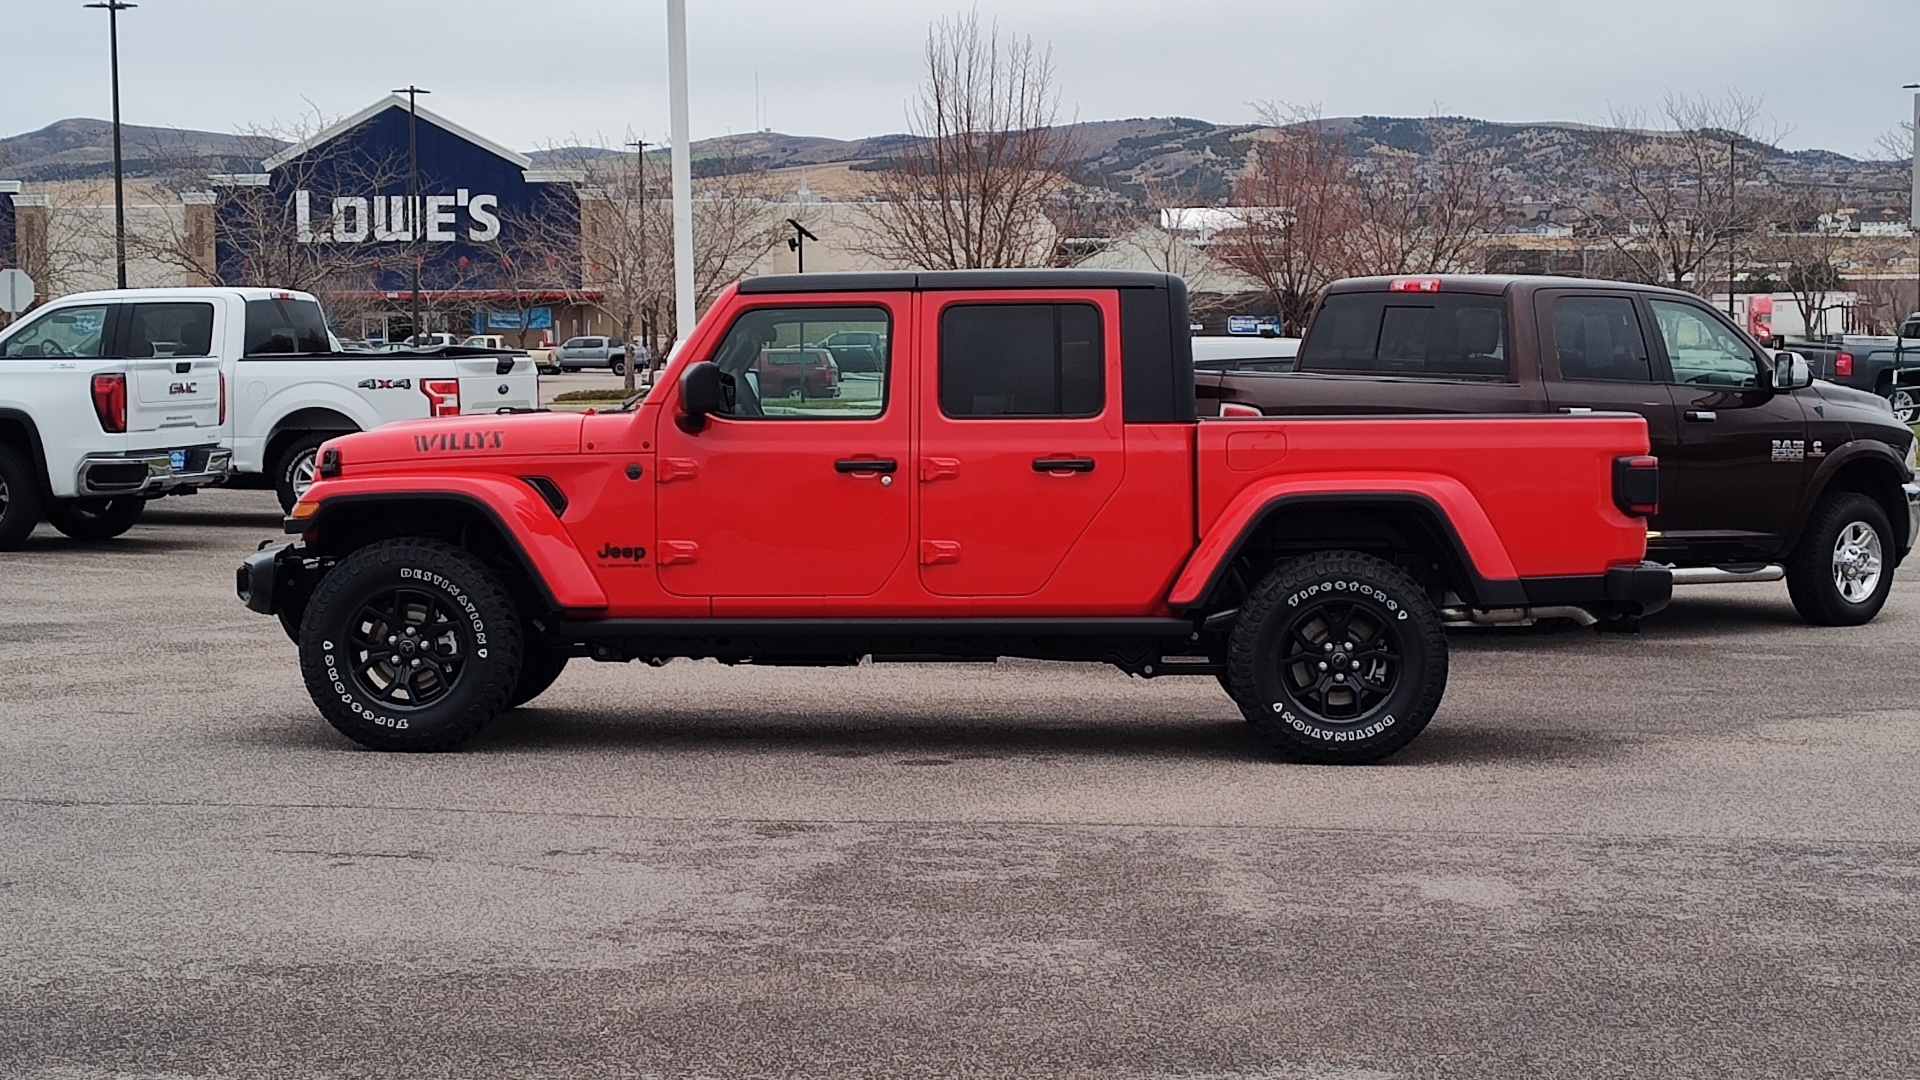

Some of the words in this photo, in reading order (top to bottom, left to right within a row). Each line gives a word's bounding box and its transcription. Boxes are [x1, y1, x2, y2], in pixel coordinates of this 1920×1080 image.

[295, 188, 500, 243] LOWE'S
[169, 382, 197, 395] GMC
[414, 430, 504, 452] WILLYS
[597, 542, 646, 562] Jeep
[401, 568, 488, 645] DESTINATION
[1281, 711, 1396, 742] DESTINATION
